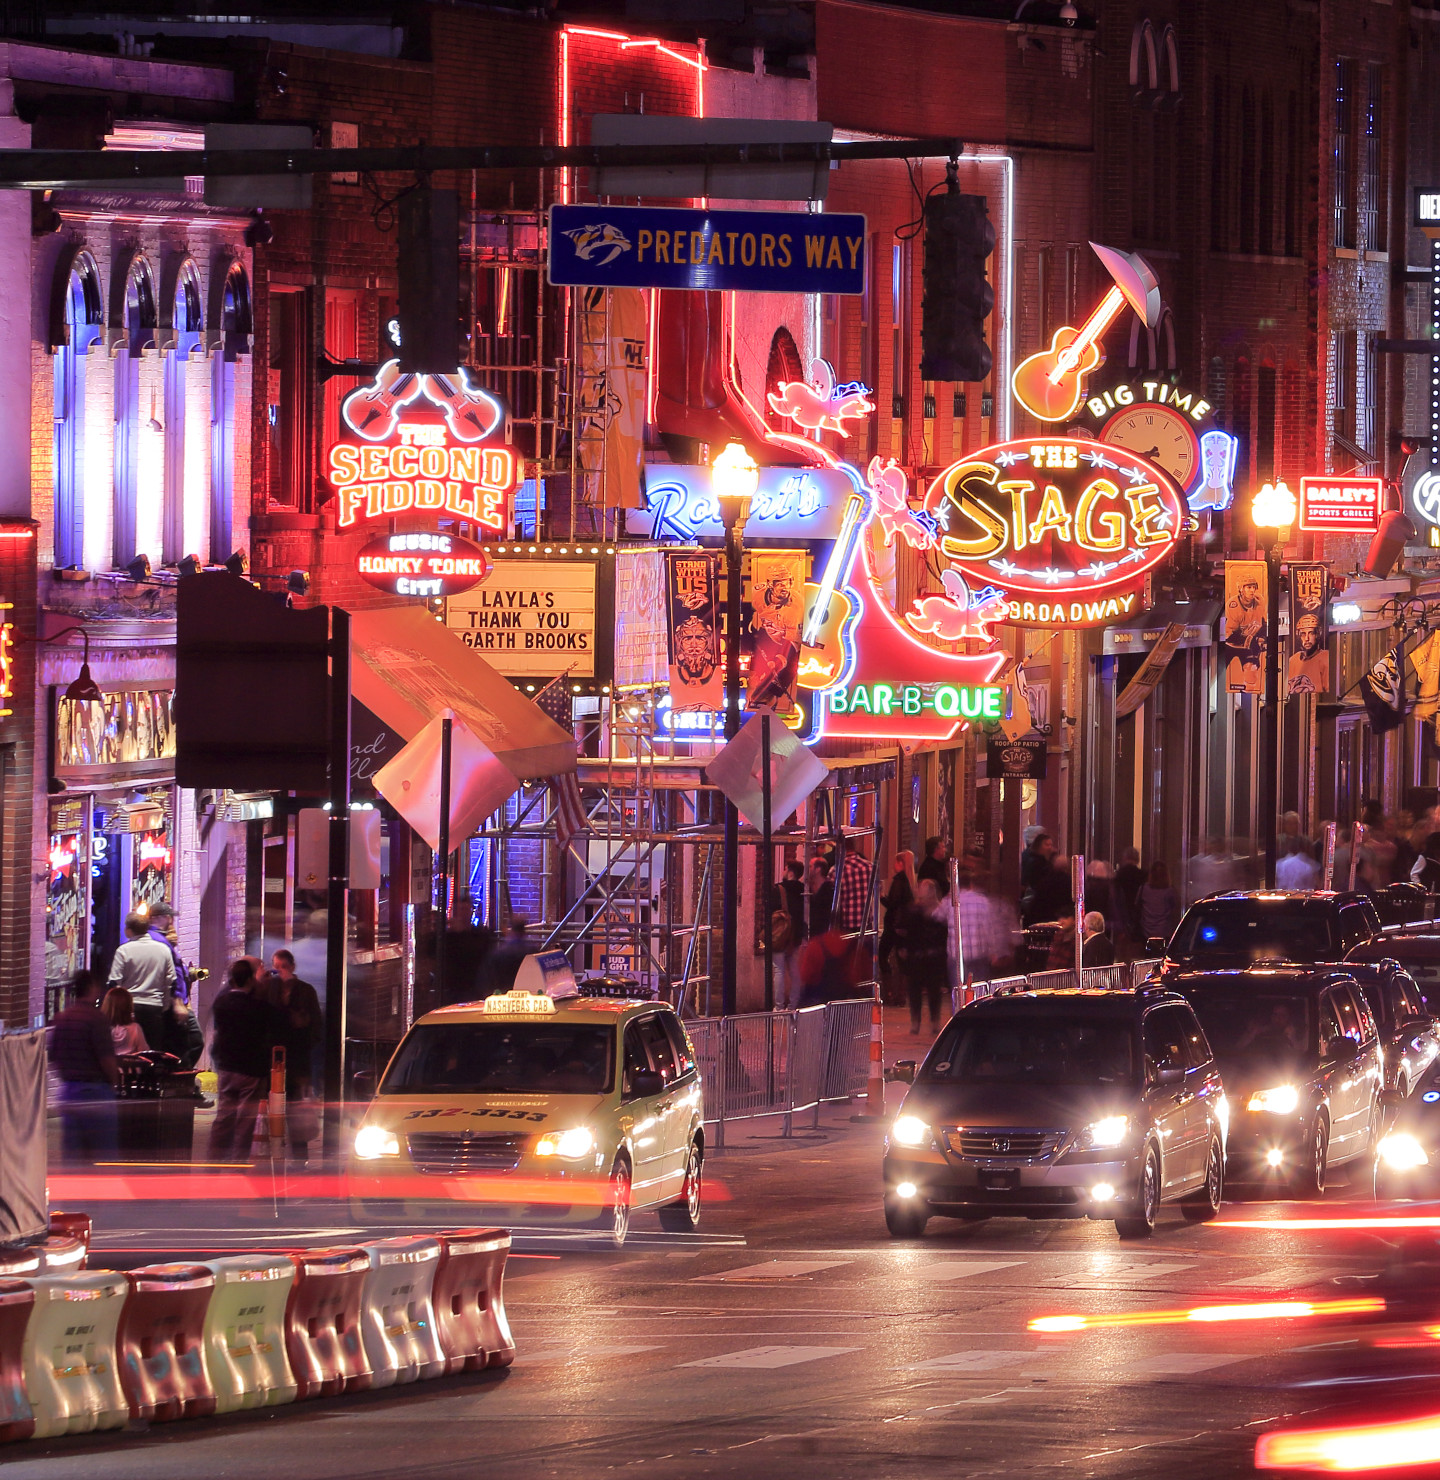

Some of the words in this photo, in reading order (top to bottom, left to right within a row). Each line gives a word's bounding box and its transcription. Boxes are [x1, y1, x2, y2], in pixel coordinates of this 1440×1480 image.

[637, 229, 793, 268] PREDATORS
[805, 235, 863, 270] WAY
[1087, 384, 1134, 418] BIG
[1143, 382, 1211, 420] TIME
[399, 424, 447, 446] THE
[1030, 445, 1078, 469] THE
[330, 444, 513, 494] SECOND
[1307, 486, 1376, 502] BAILEY'S
[338, 480, 504, 529] FIDDLE
[645, 473, 829, 541] Rort's
[941, 460, 1173, 560] STAGE
[1309, 508, 1343, 517] SPORTS
[1345, 508, 1375, 517] GRILLE
[389, 533, 451, 553] MUSIC
[359, 556, 423, 575] HONKY
[428, 558, 482, 576] TONK
[675, 560, 707, 569] STAND
[675, 568, 707, 577] WITH
[396, 578, 443, 597] CITY
[677, 577, 707, 594] US
[1297, 576, 1321, 584] WITH
[482, 591, 554, 608] LAYLA'S
[1297, 583, 1321, 598] US
[1009, 593, 1136, 624] BROADWAY
[468, 611, 522, 630] THANK
[538, 612, 570, 631] YOU
[462, 632, 516, 650] GARTH
[525, 632, 588, 650] BROOKS
[830, 684, 1002, 717] BAR-B-QUE
[1001, 749, 1033, 762] STAGE
[601, 963, 629, 971] LGHT
[487, 1000, 530, 1012] NASHVEGAS
[533, 1000, 548, 1012] CAB
[403, 1107, 549, 1123] 332-3333
